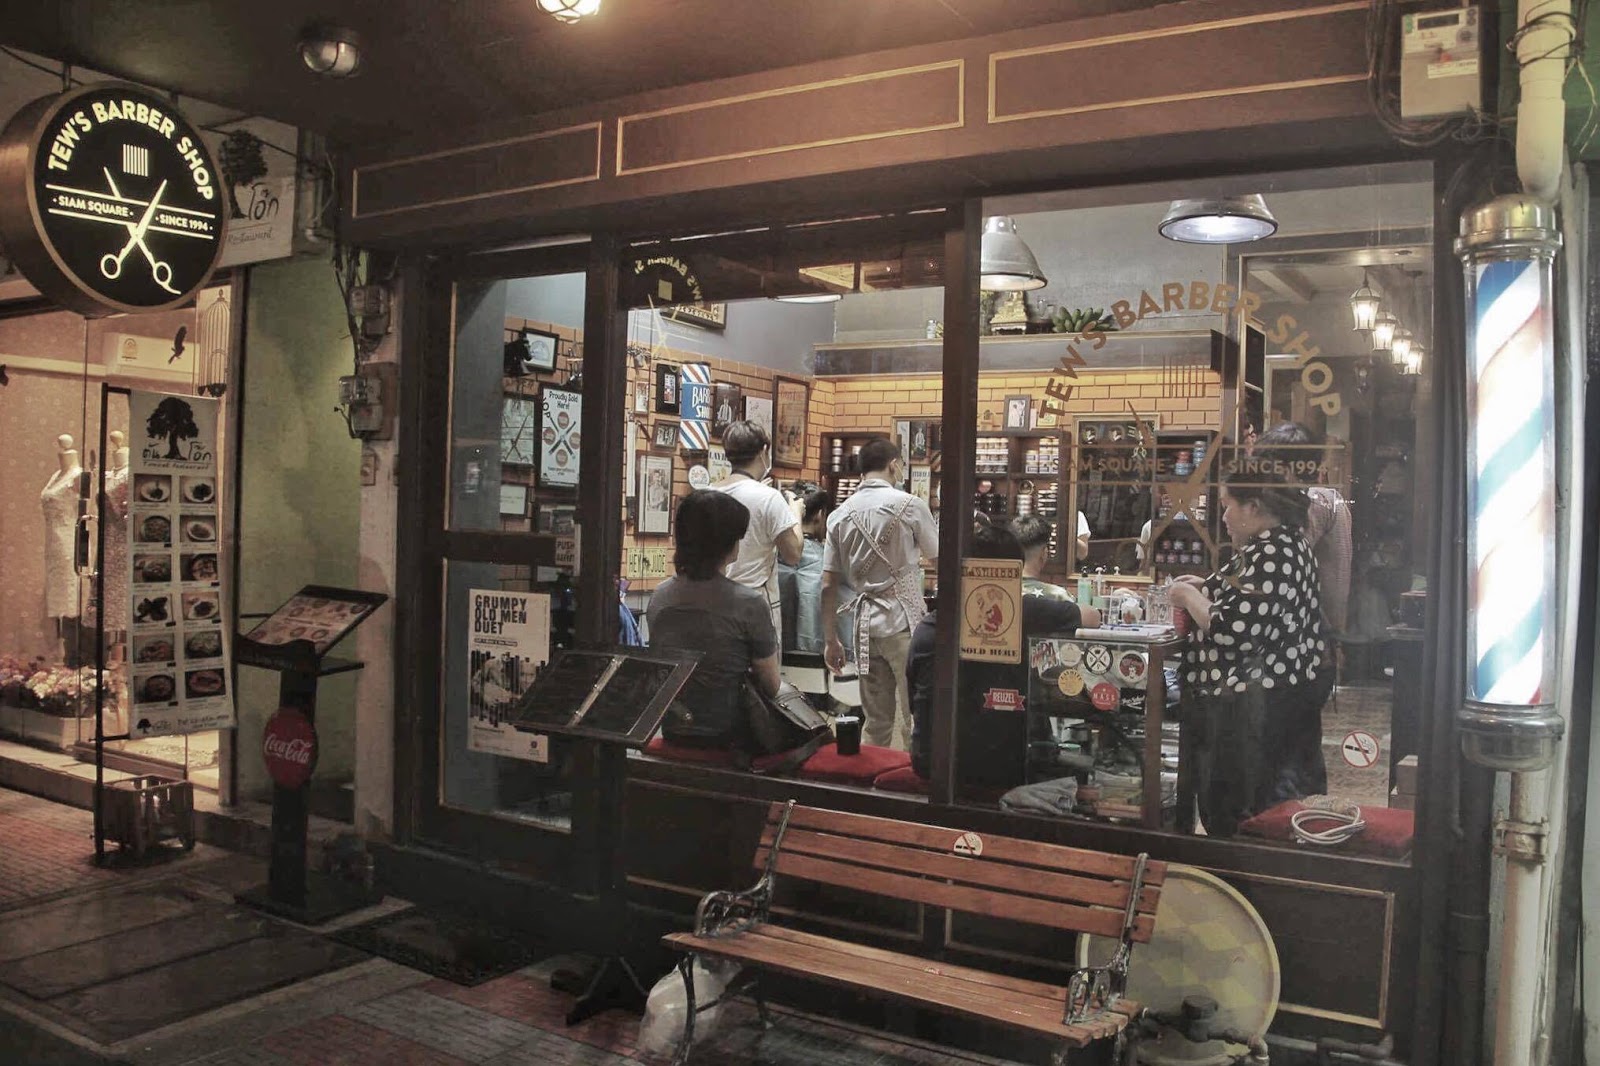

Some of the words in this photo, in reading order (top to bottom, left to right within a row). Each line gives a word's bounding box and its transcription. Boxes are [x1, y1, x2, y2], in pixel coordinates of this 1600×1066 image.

[48, 111, 92, 171] TEW'S
[92, 100, 175, 140] BARBER
[176, 136, 214, 200] SHOP
[59, 195, 86, 210] SIAM
[88, 200, 129, 217] SQUARE
[159, 214, 188, 229] SINCE
[189, 218, 209, 232] 1994
[1040, 320, 1107, 418] TEW'S
[1110, 281, 1262, 330] BARBER
[1267, 315, 1342, 416] SHOP
[549, 390, 568, 402] Proudly
[1098, 457, 1166, 473] SQUARE
[1228, 459, 1287, 474] SINCE
[1288, 461, 1328, 475] 1994
[475, 594, 527, 611] GRUMPY
[475, 607, 496, 621] OLD
[501, 609, 527, 624] MEN
[474, 619, 504, 635] DUET
[961, 646, 986, 655] SOLD
[992, 692, 1015, 703] REUZEL
